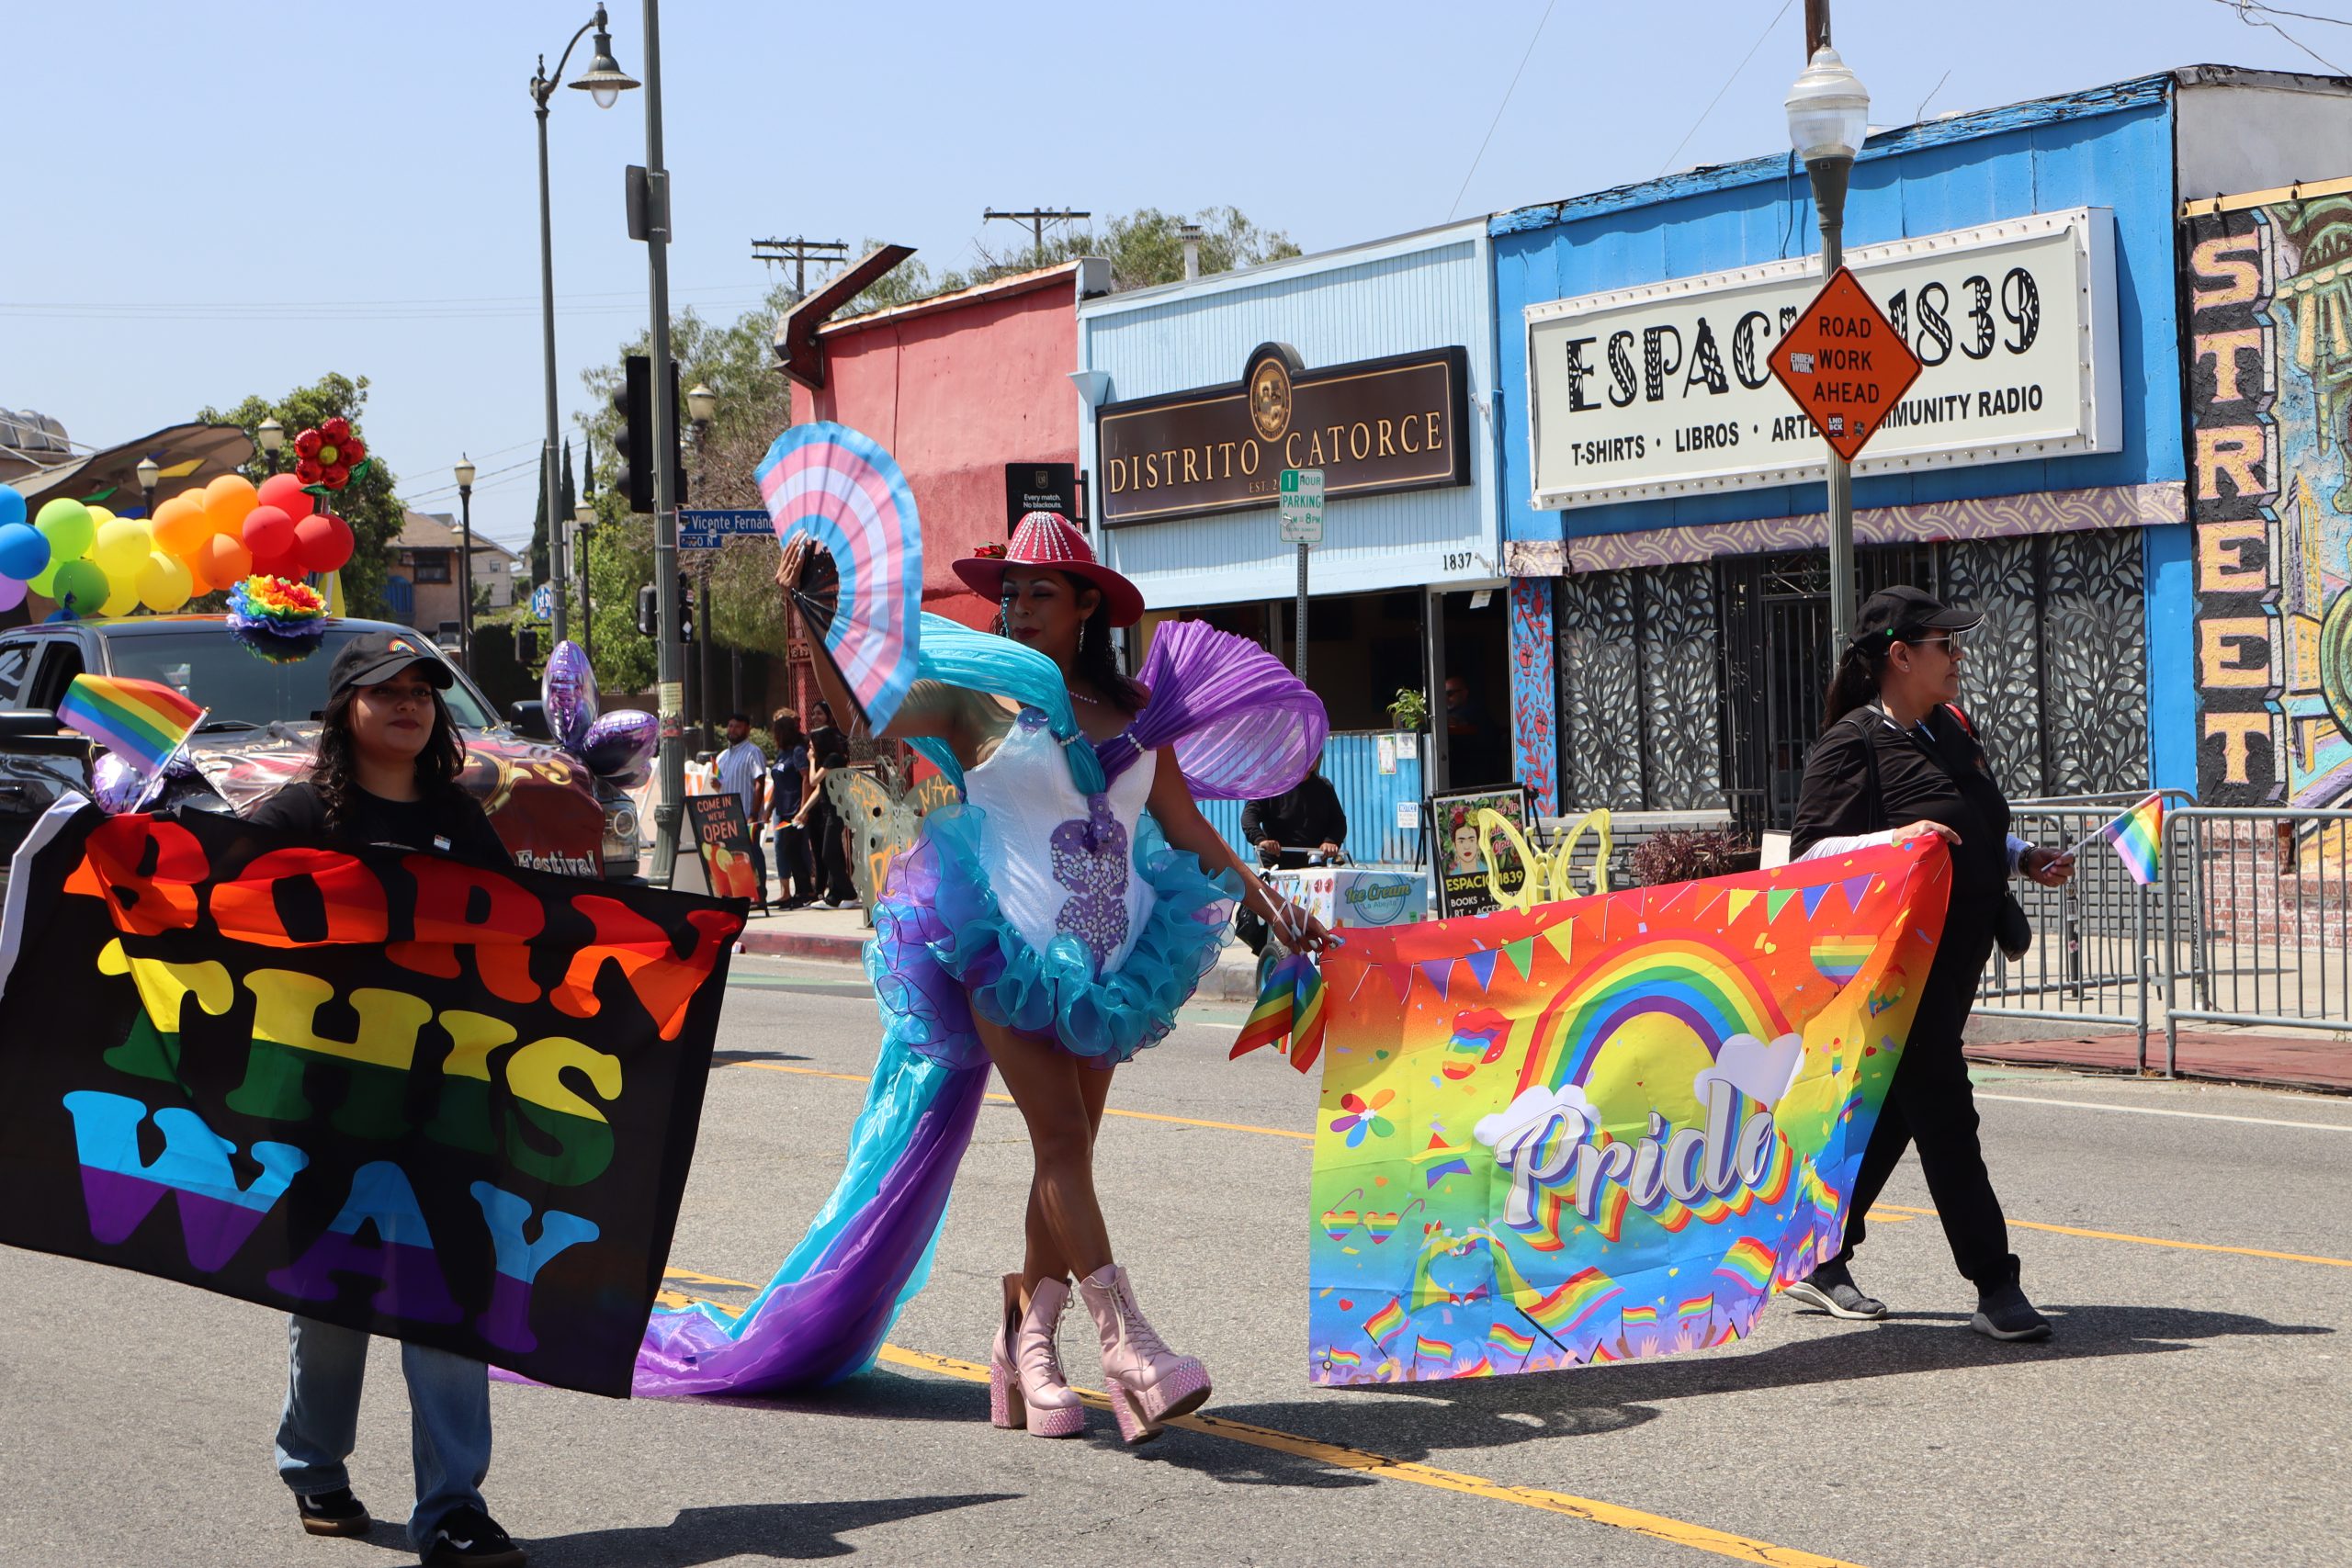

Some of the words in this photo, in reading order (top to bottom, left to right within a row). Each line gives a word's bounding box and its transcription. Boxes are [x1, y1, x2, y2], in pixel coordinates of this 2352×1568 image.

[1819, 316, 1871, 338] ROAD
[1566, 306, 1797, 412] ESPAC
[1819, 349, 1873, 371] WORK
[1813, 382, 1880, 403] AHEAD
[1571, 435, 1645, 466] T-SHIRTS
[1676, 422, 1739, 452] LIBROS
[1978, 384, 2042, 417] RADIO
[1110, 438, 1261, 493] DISTRITO
[1285, 411, 1442, 469] CATORCE
[1250, 480, 1269, 493] EST.
[1288, 473, 1292, 490] 1
[1299, 476, 1321, 486] HOUR
[1023, 493, 1041, 502] Every
[1041, 493, 1061, 502] match.
[1283, 495, 1321, 508] PARKING
[2190, 226, 2271, 785] STREET
[691, 515, 730, 529] Vicente
[1443, 552, 1472, 570] 1837
[696, 797, 721, 813] COME
[722, 795, 732, 807] IN
[703, 820, 738, 842] OPEN
[515, 850, 598, 876] Festival
[1345, 888, 1366, 904] Ice
[1368, 883, 1412, 902] Cream
[1451, 896, 1477, 908] BOOKS
[64, 813, 743, 1042] BORN
[97, 937, 623, 1186] THIS
[1494, 1078, 1777, 1231] Pride
[62, 1089, 600, 1354] WAY
